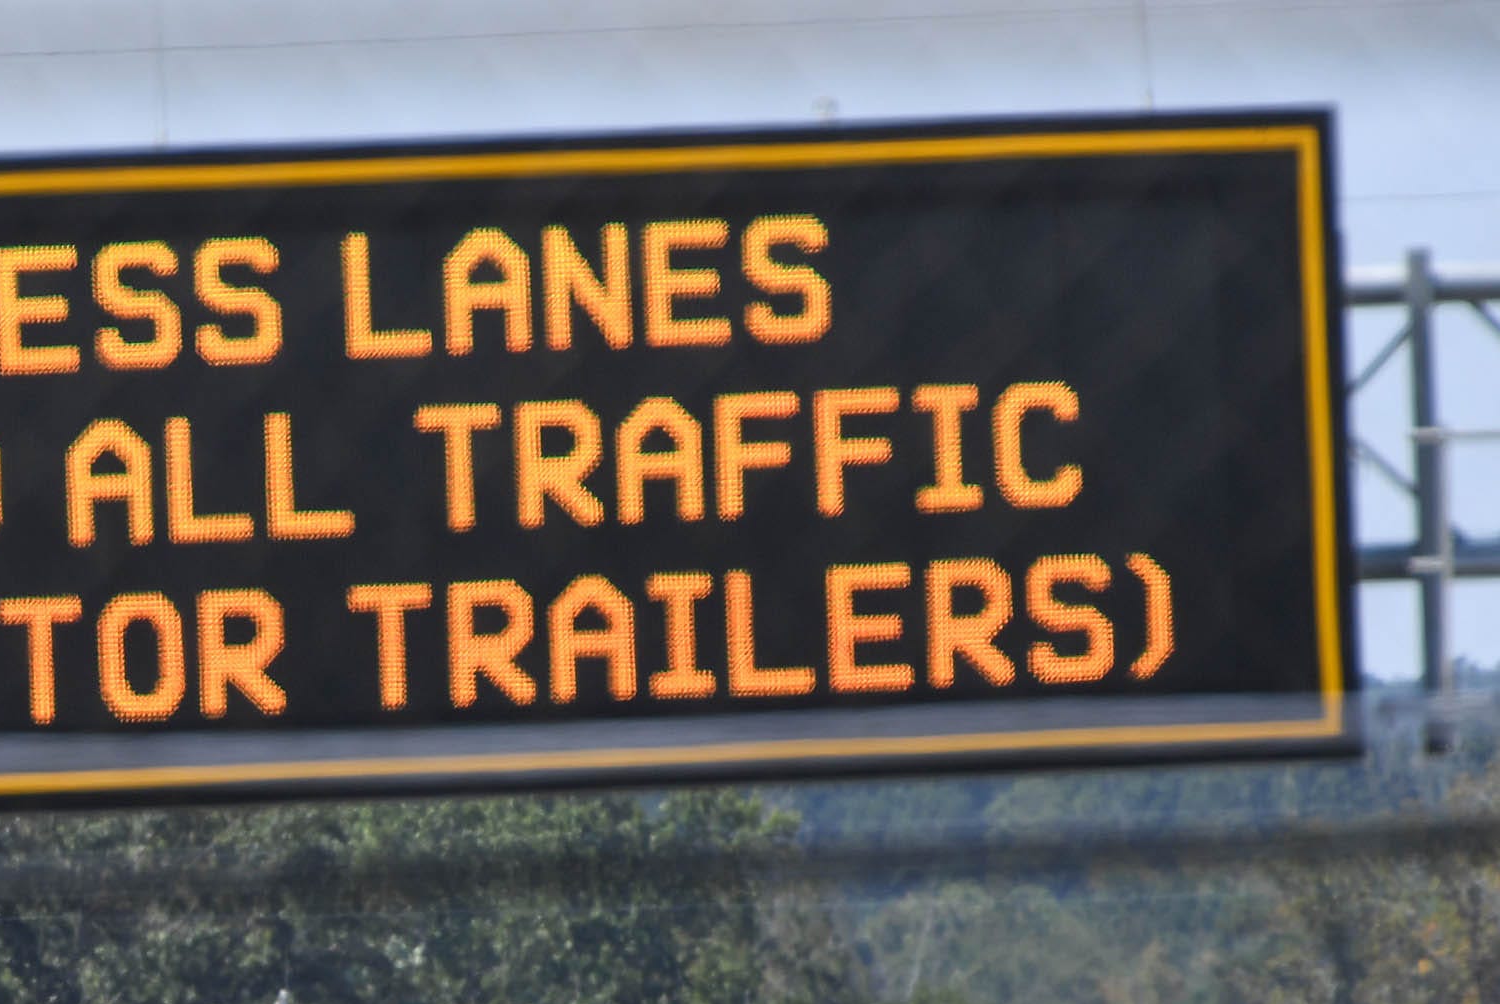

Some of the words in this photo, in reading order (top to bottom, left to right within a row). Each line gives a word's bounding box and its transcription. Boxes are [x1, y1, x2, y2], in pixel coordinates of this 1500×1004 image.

[342, 216, 831, 359] LANES
[66, 413, 354, 547] ALL
[414, 382, 1082, 531] TRAFFIC
[348, 554, 1173, 709] TRAILERS)
